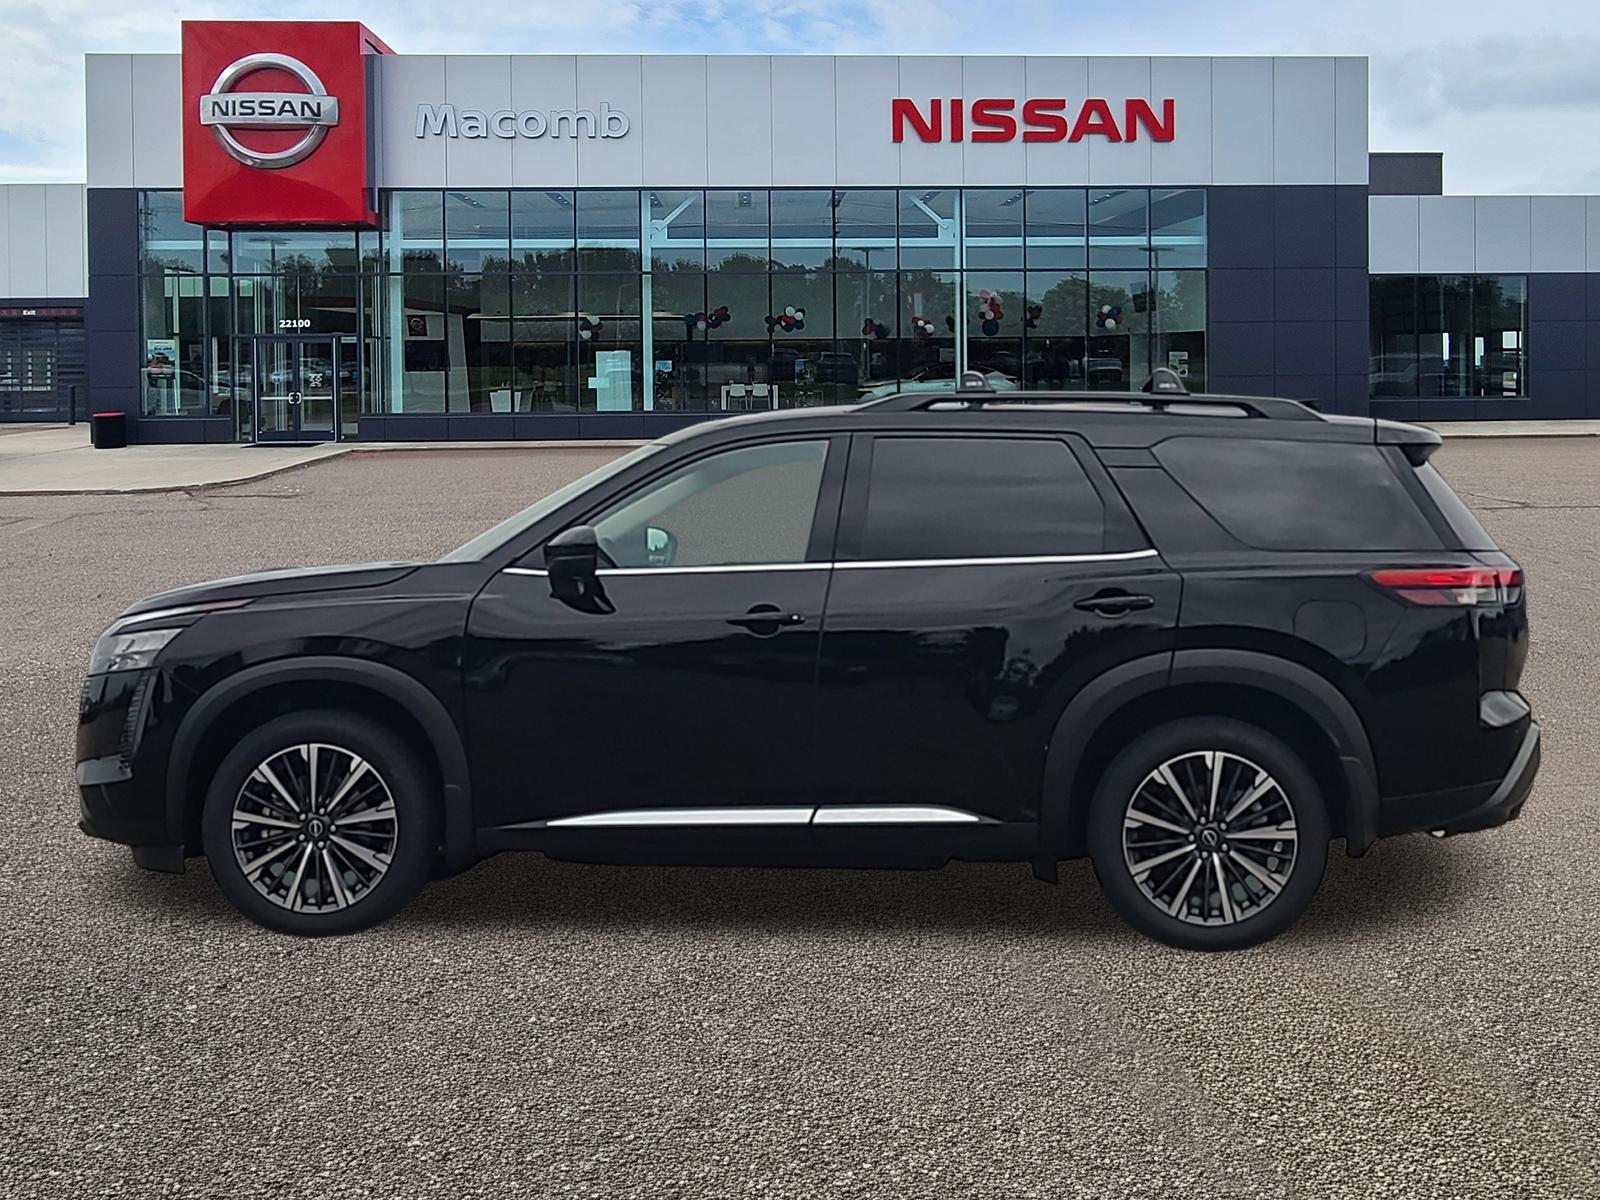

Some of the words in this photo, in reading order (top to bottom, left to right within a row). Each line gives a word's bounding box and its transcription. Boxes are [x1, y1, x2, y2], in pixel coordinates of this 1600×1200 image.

[211, 100, 321, 118] NISSAN
[415, 102, 630, 138] Macomb
[892, 98, 1175, 143] NISSAN
[279, 319, 311, 328] 22100
